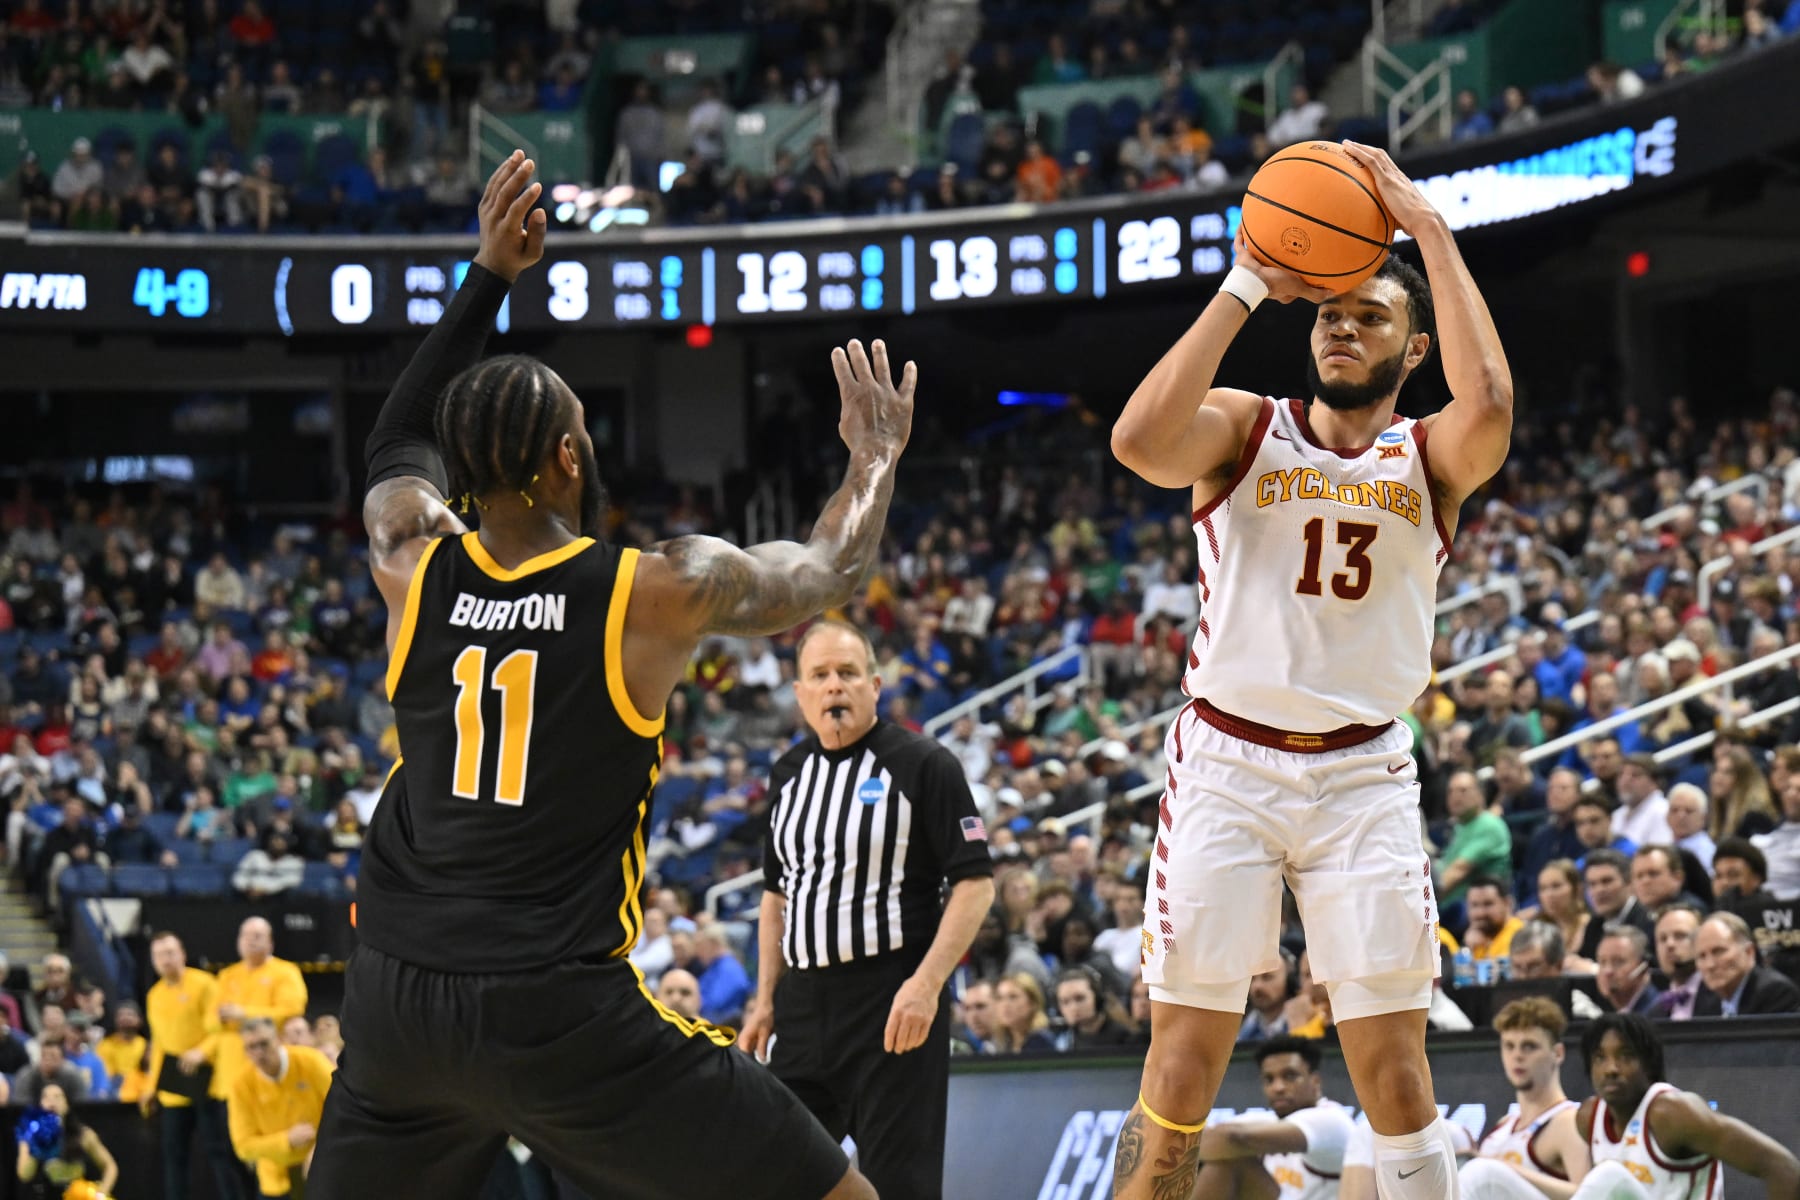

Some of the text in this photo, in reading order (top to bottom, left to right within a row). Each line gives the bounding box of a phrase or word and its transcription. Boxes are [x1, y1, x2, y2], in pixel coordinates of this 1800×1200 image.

[930, 236, 998, 300] 13
[1118, 216, 1181, 283] 22
[331, 264, 373, 324] 0
[548, 261, 589, 321] 3
[737, 251, 807, 313] 12
[1256, 468, 1421, 527] CYCLONES
[1296, 516, 1379, 601] 13
[449, 592, 566, 631] BURTON
[452, 644, 538, 807] 11
